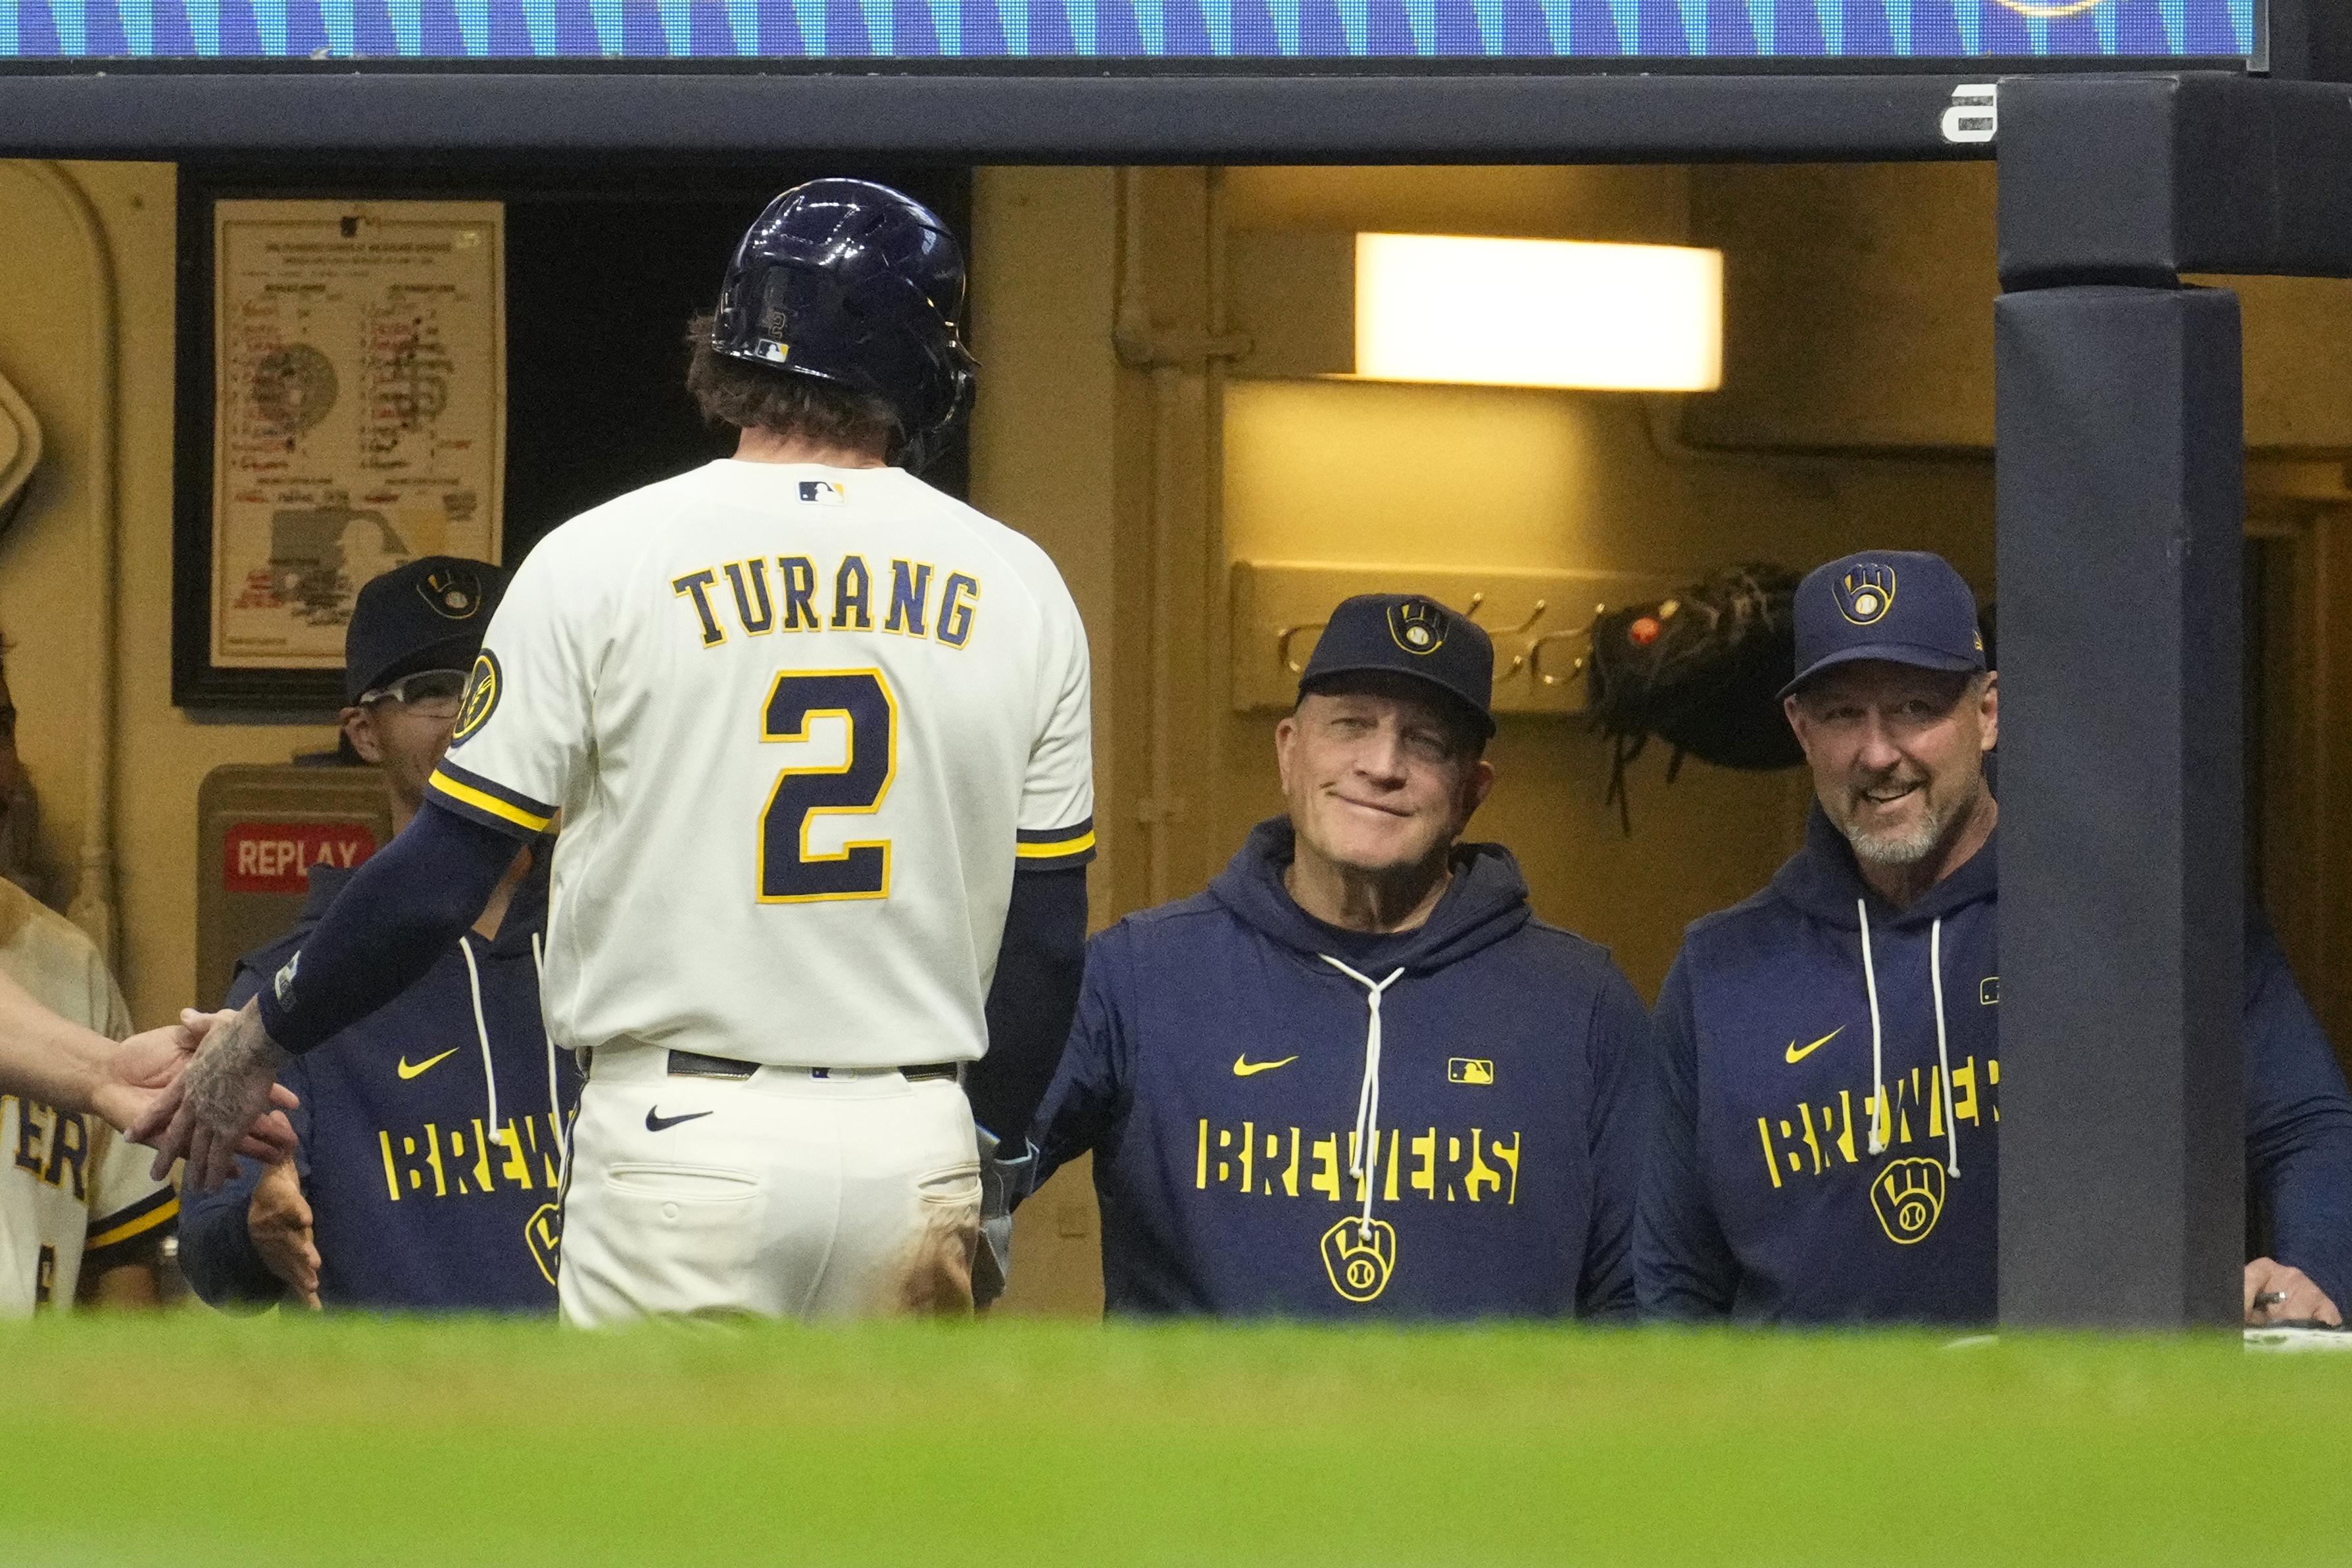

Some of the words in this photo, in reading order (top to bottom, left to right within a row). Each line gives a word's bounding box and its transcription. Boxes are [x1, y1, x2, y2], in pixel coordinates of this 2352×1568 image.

[670, 554, 981, 650] TURANG
[756, 667, 897, 904] 2
[237, 839, 358, 877] REPLAY
[1196, 1119, 1520, 1204] BREWERS
